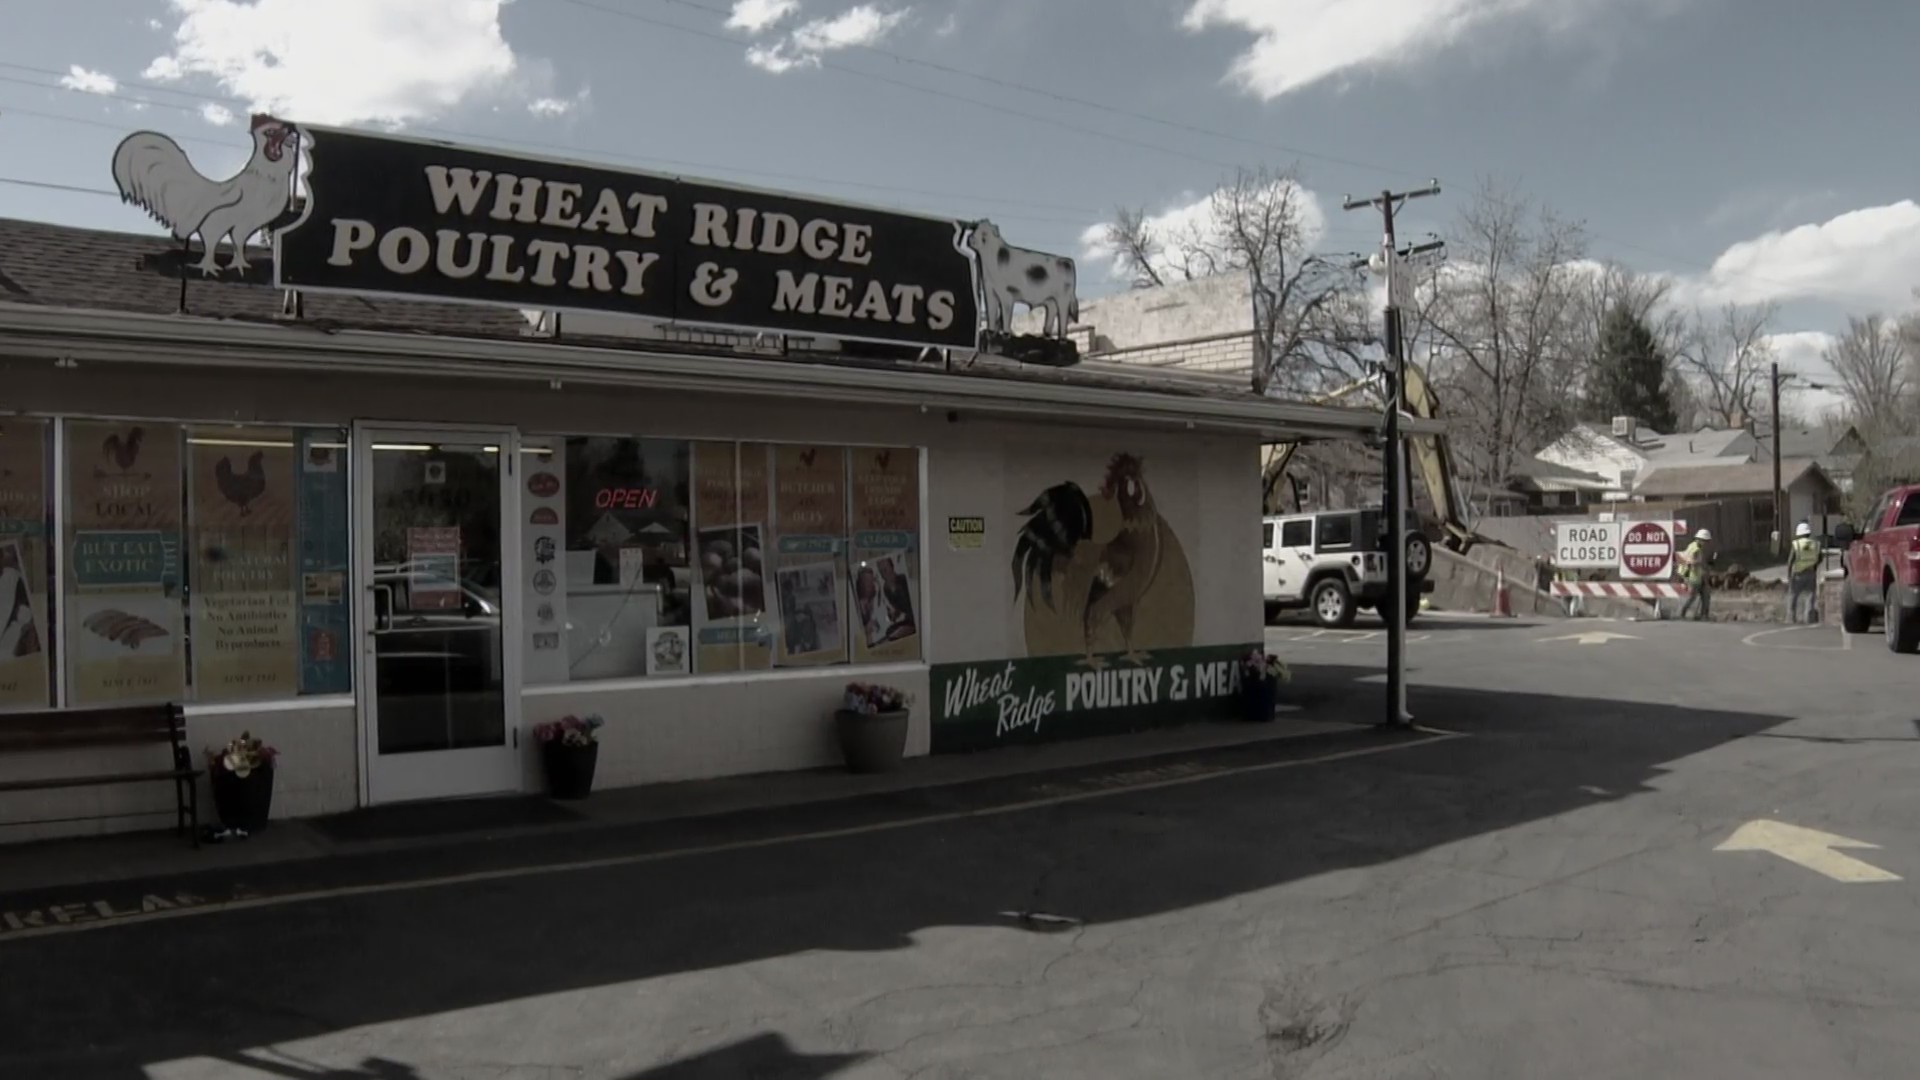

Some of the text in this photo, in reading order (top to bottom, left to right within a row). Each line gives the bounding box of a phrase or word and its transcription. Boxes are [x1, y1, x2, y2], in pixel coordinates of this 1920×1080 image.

[424, 164, 873, 266] WHEAT RIDGE
[327, 217, 956, 331] POULTRY & MEATS
[595, 488, 658, 508] OPEN
[95, 502, 155, 518] LOCAL
[951, 519, 983, 532] CAUTION
[1569, 528, 1608, 542] ROAD
[1628, 532, 1665, 542] DO NOT
[82, 541, 116, 555] BUT
[1560, 547, 1617, 560] CLOSED
[85, 558, 154, 573] EXOTIC
[1630, 557, 1661, 567] ENTER
[204, 597, 266, 609] Vegetarian
[237, 625, 278, 636] Animal
[944, 661, 1017, 719] Wheat
[1066, 660, 1243, 712] POULTRY & MEA
[996, 685, 1056, 737] Ridge
